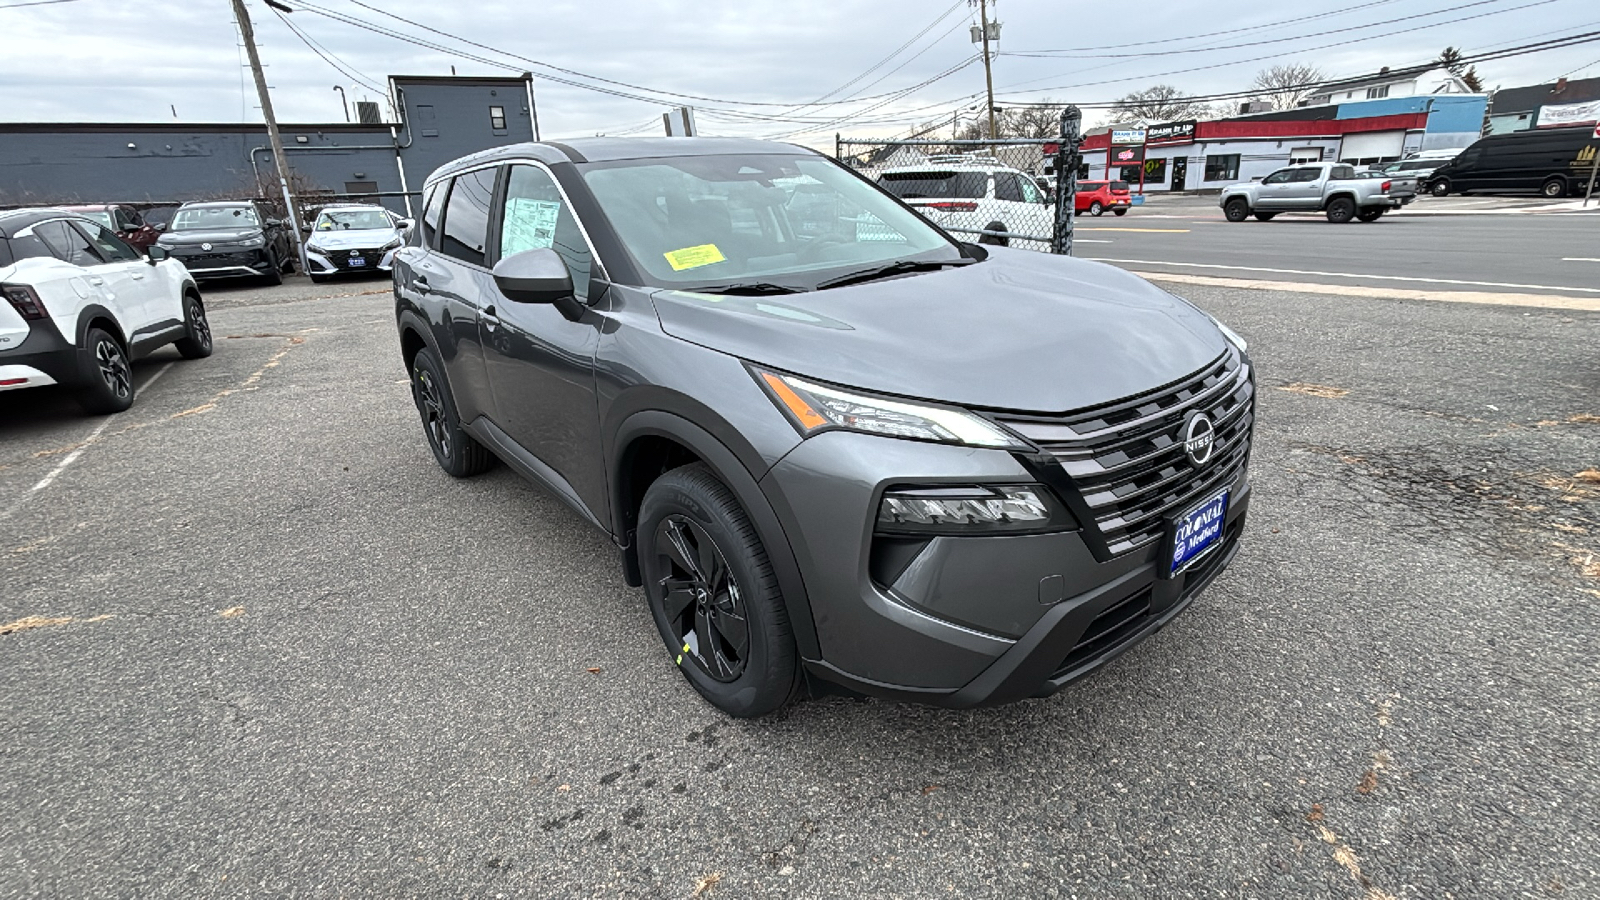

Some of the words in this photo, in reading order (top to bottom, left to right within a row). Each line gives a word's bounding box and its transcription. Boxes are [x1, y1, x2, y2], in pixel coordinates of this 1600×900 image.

[1186, 432, 1213, 452] NISS
[1174, 501, 1224, 545] COLONIAL
[1187, 520, 1220, 551] Medford
